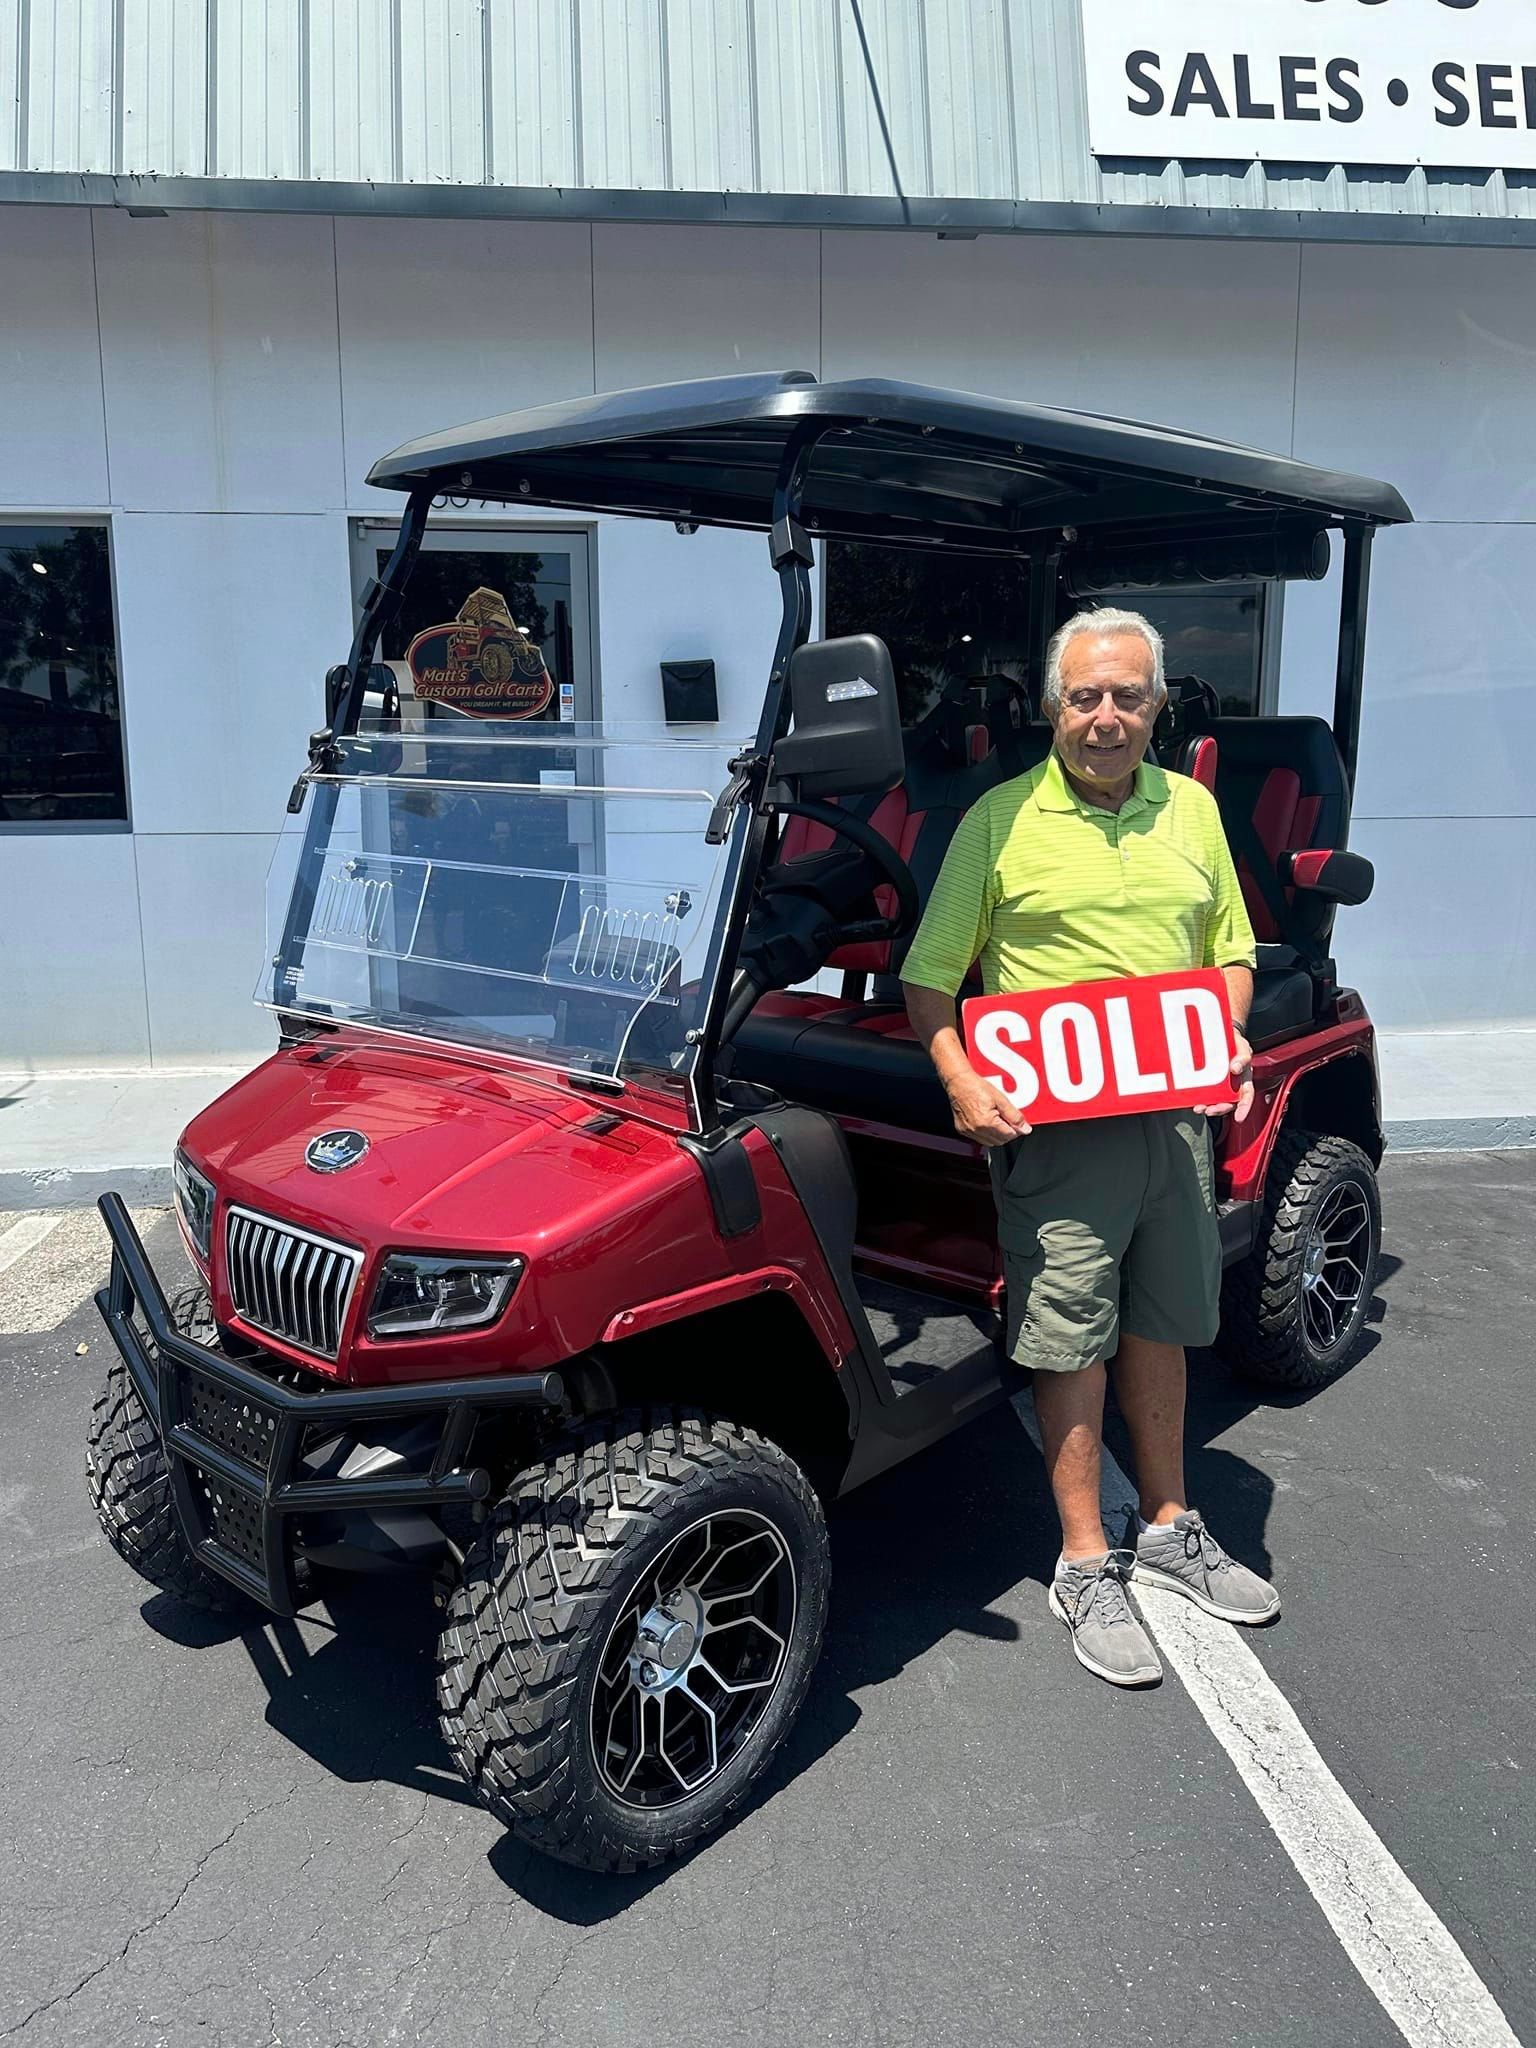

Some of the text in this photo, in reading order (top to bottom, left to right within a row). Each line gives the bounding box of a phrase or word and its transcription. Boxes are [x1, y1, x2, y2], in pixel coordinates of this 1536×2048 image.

[1125, 50, 1364, 123] SALES
[415, 683, 545, 697] Custom Golf Carts
[422, 669, 468, 682] Matt's
[974, 987, 1230, 1110] SOLD
